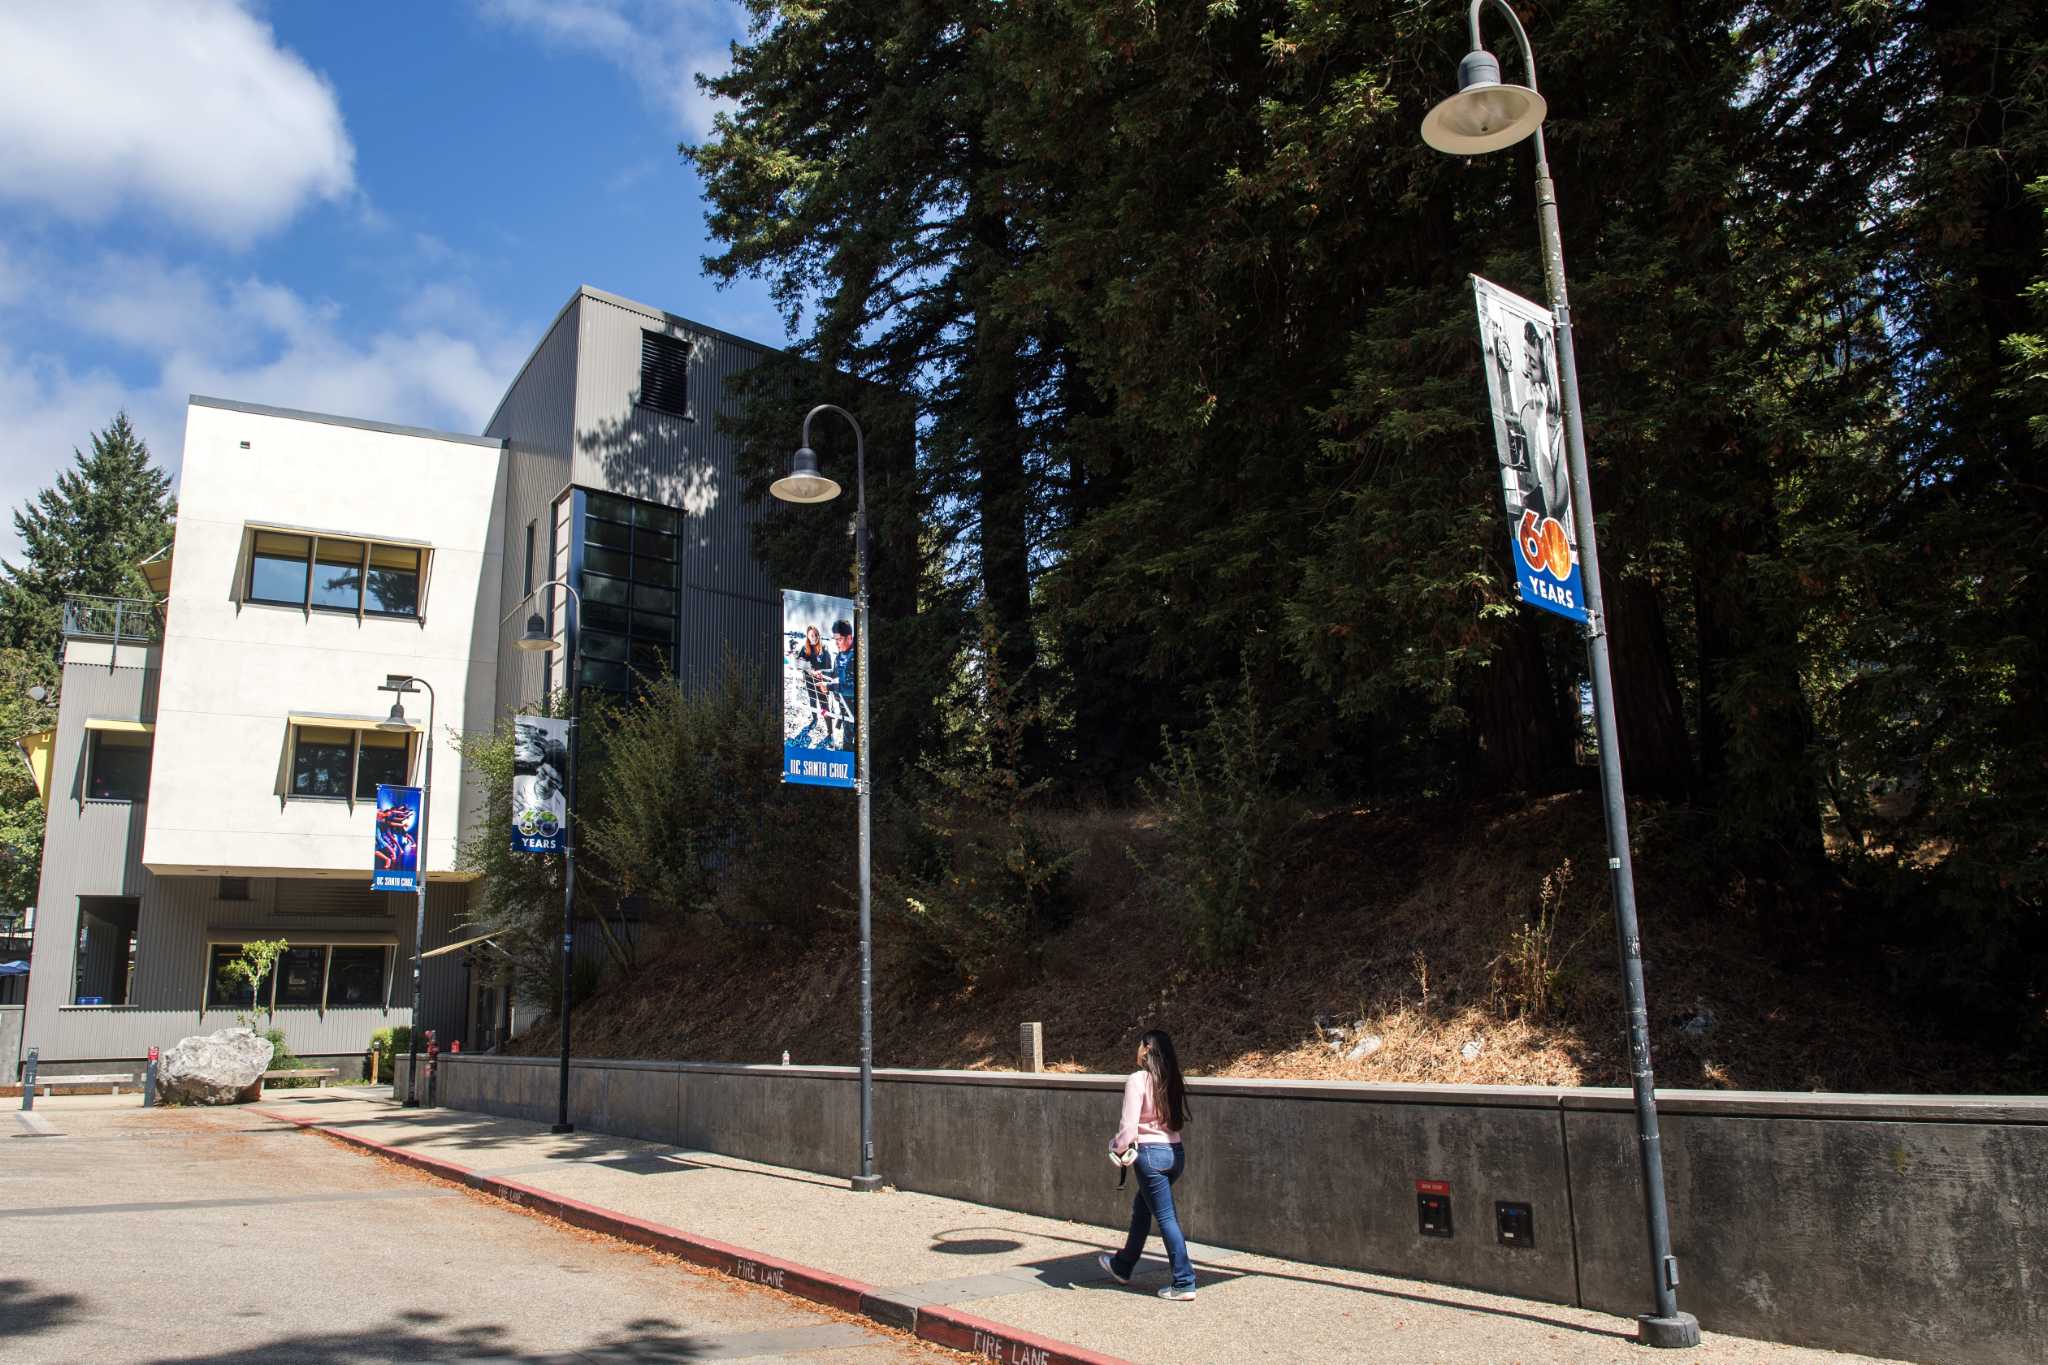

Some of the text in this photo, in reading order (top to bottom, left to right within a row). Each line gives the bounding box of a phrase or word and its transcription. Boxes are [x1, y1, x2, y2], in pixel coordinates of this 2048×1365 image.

[1518, 508, 1572, 581] 60
[1529, 576, 1574, 609] YEARS
[790, 759, 849, 779] UC SANTA CRUZ
[521, 838, 557, 849] YEARS
[737, 1260, 785, 1288] FIRE LANE
[974, 1331, 1002, 1359] FIRE
